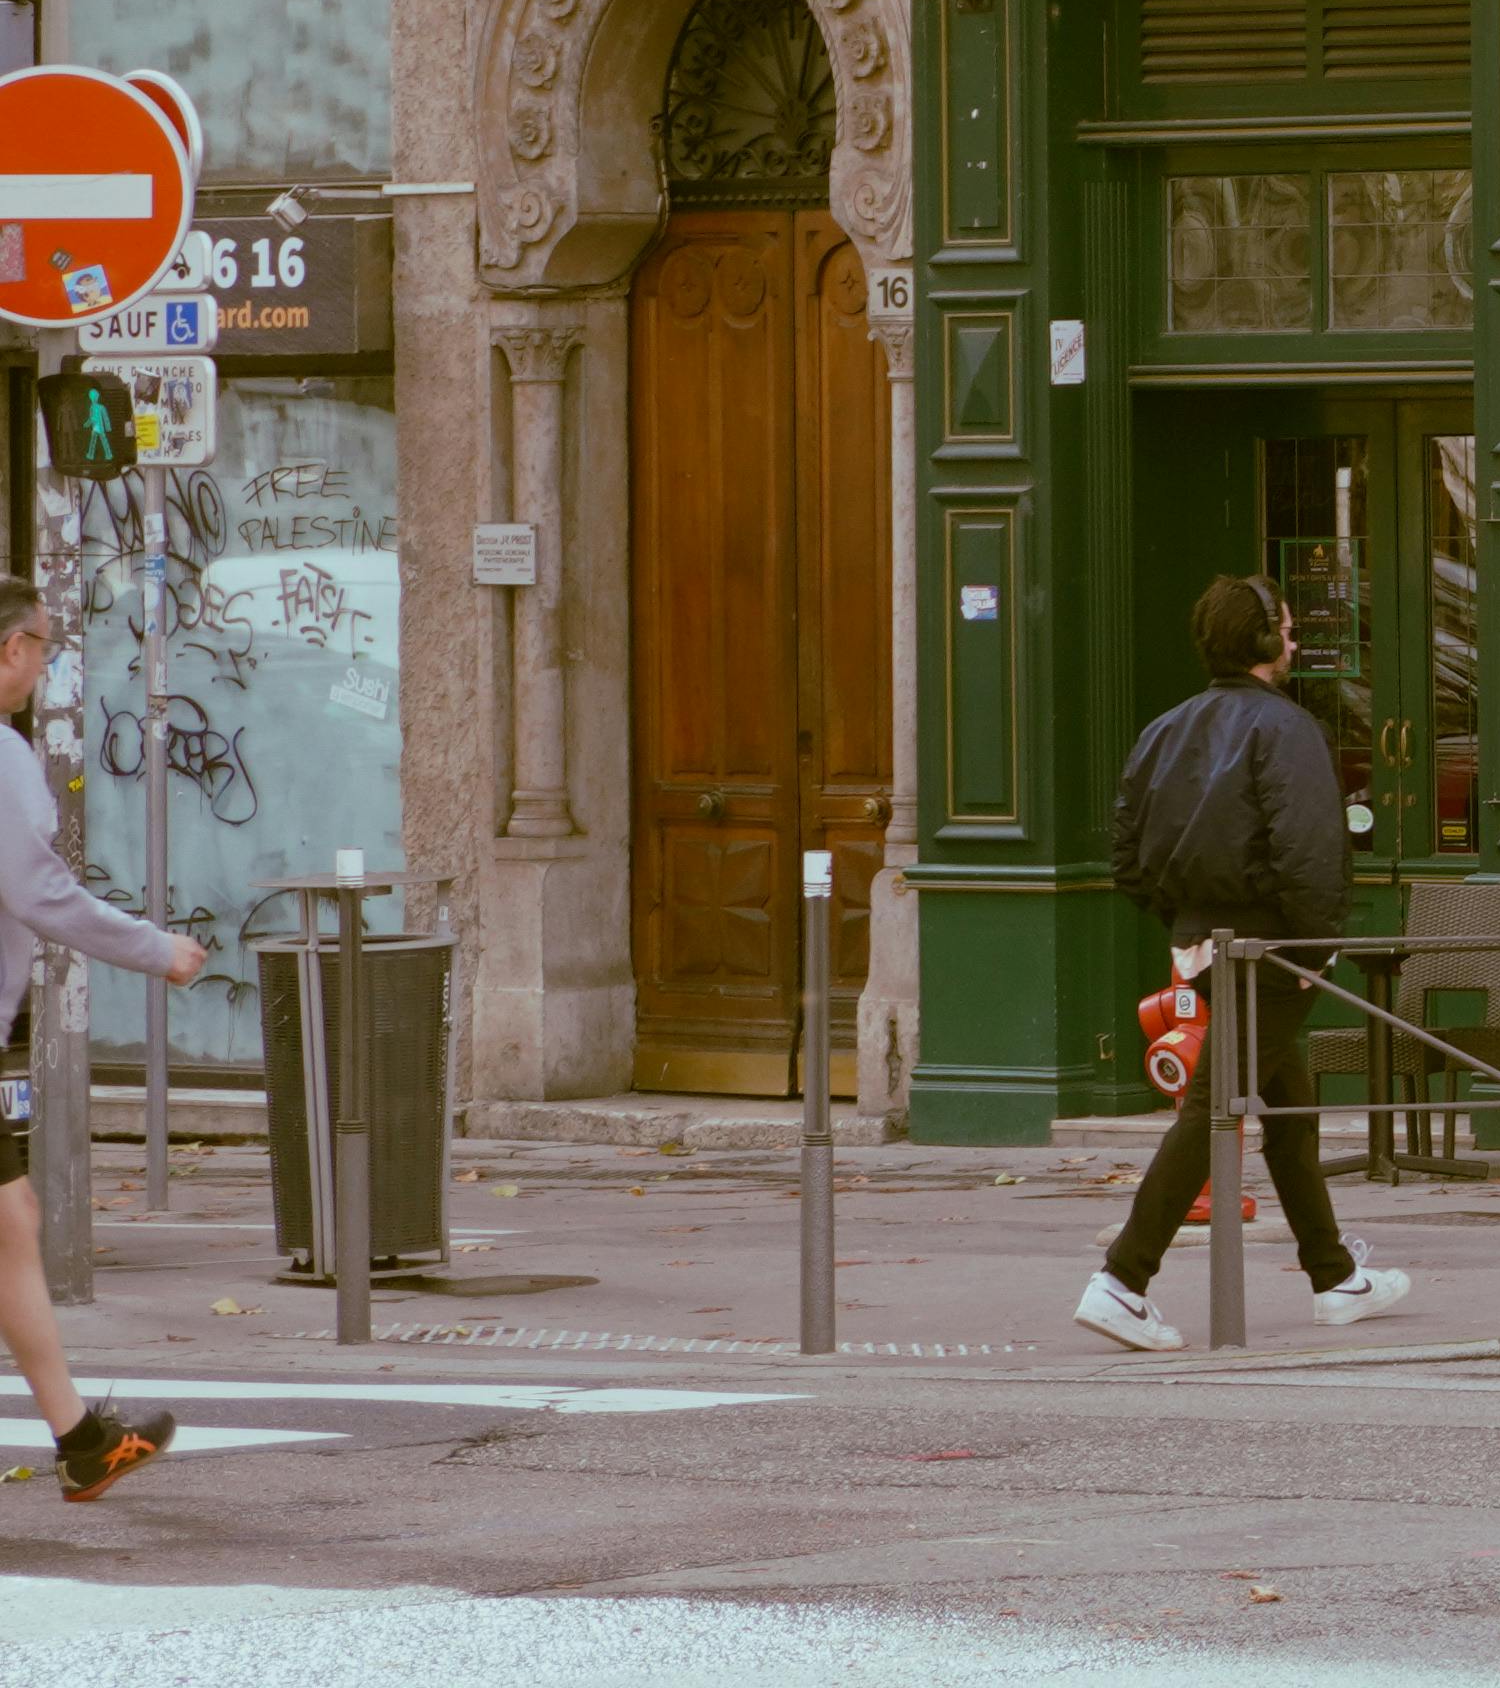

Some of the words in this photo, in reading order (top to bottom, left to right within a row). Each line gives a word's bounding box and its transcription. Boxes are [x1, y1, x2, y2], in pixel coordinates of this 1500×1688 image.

[251, 236, 306, 289] 16
[877, 275, 908, 309] 16
[89, 311, 158, 340] SAUF
[131, 366, 195, 378] DMANCHE
[242, 463, 350, 508] FREE
